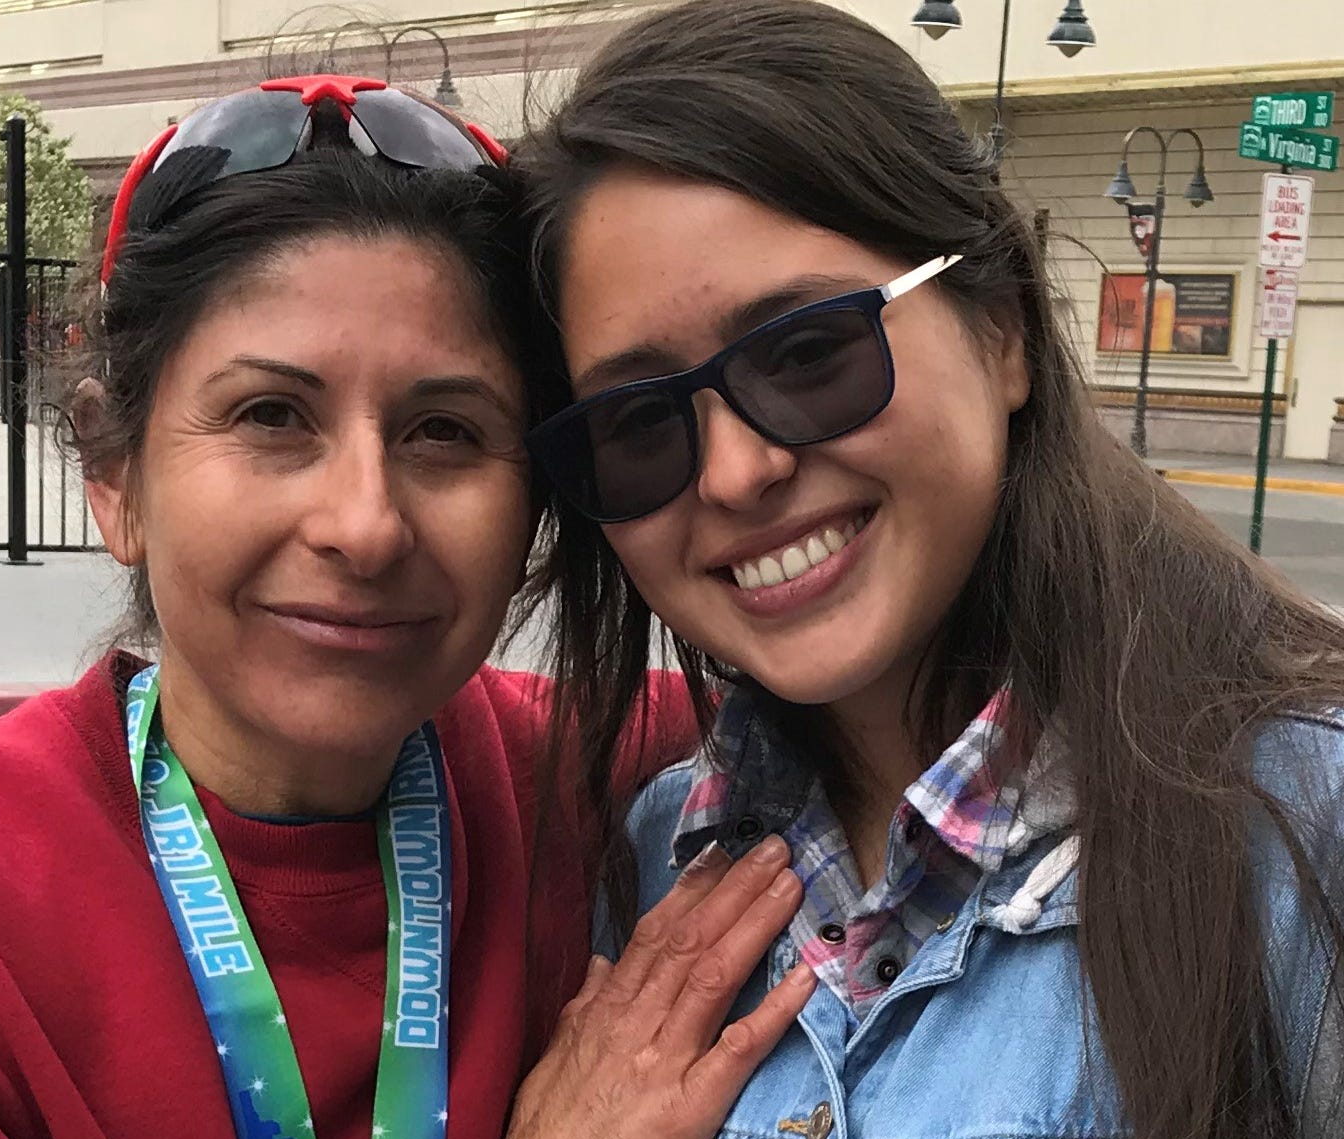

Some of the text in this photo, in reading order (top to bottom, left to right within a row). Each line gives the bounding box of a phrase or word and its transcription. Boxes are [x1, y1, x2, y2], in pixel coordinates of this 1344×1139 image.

[1270, 99, 1307, 125] THIRD
[1268, 132, 1316, 164] Virginia
[1278, 185, 1299, 200] BUS
[1268, 200, 1306, 215] LOADING
[1274, 215, 1297, 230] AREA
[170, 875, 254, 977] MILE
[389, 803, 442, 1049] DOWNTOWN
